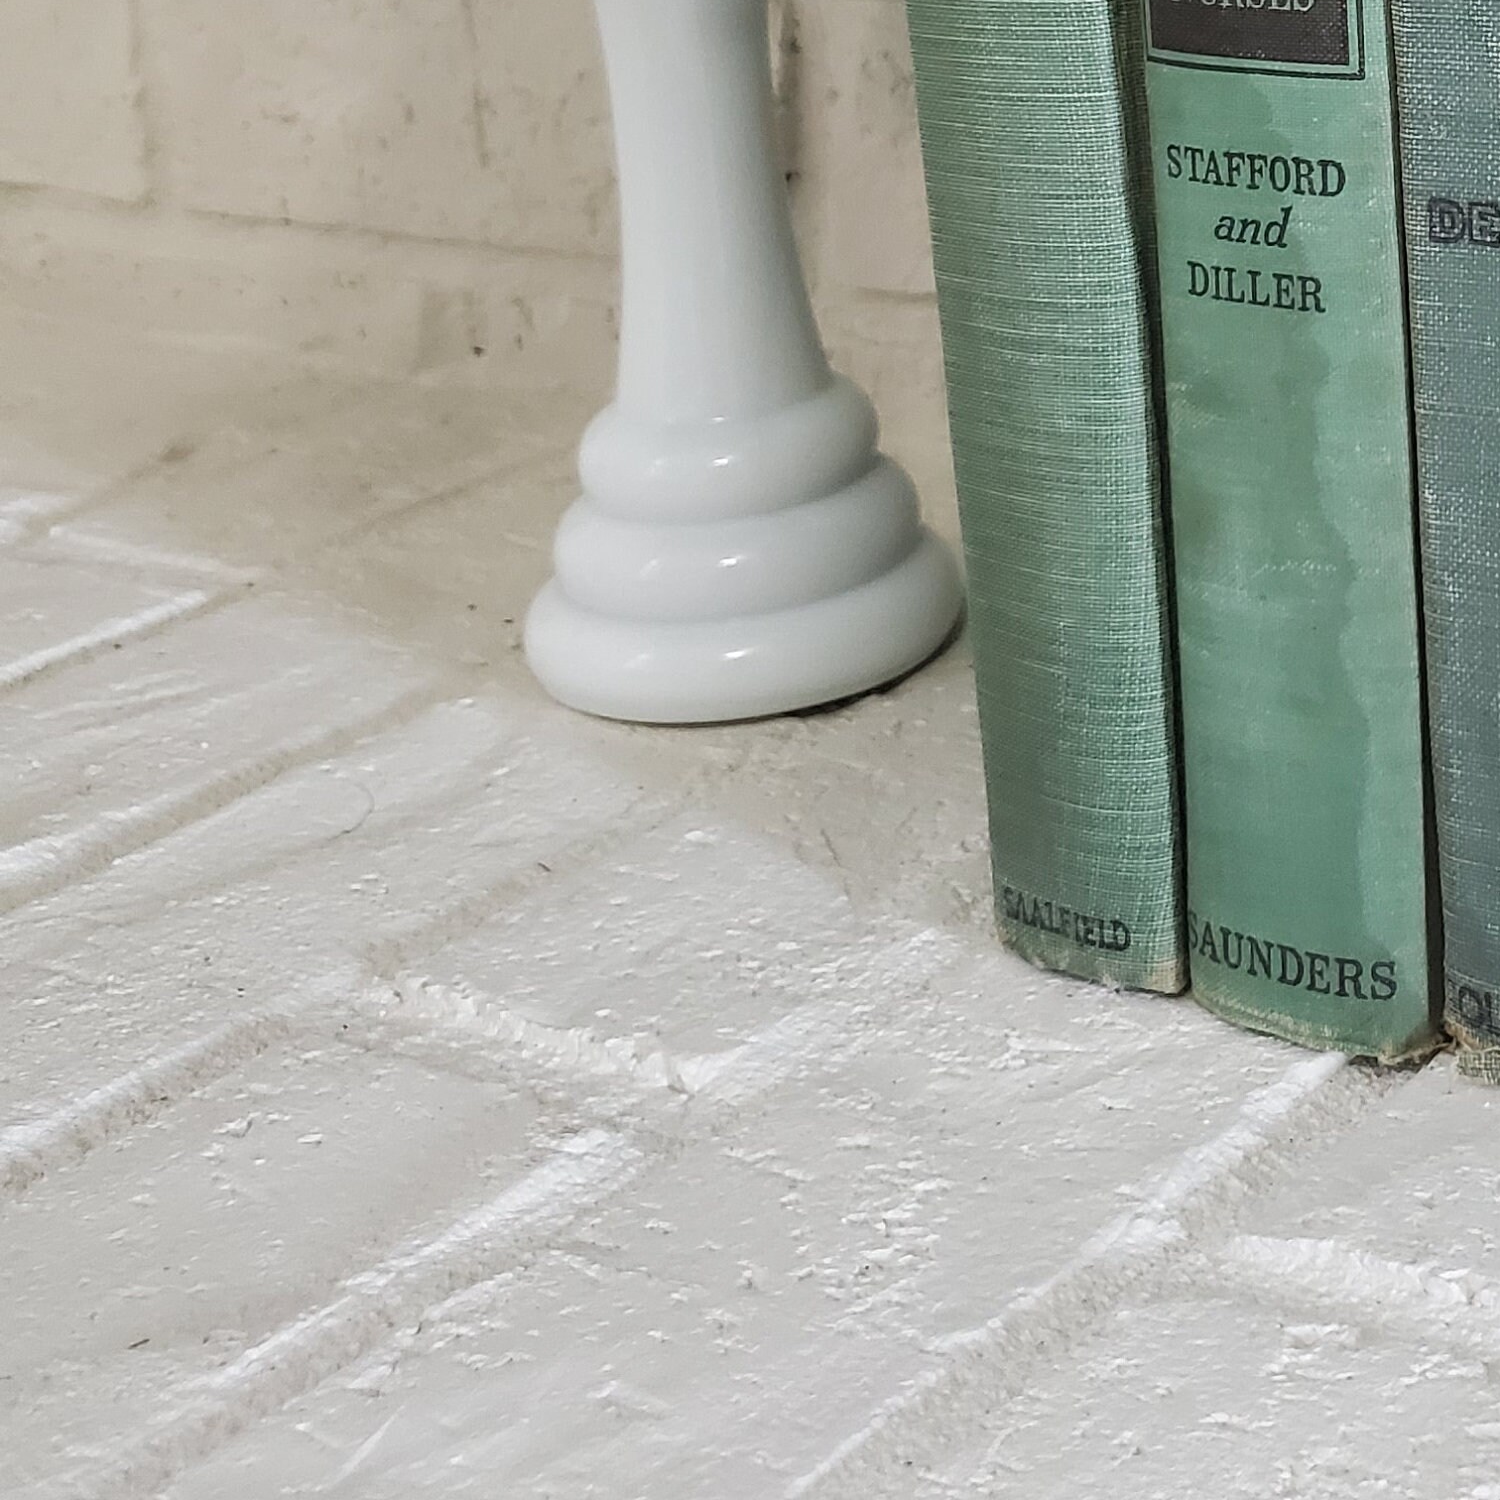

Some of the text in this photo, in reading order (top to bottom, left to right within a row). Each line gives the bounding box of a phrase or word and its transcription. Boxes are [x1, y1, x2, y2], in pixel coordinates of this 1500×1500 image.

[1166, 144, 1347, 197] STAFFORD
[1214, 206, 1294, 249] and
[1187, 261, 1326, 314] DILLER
[1187, 910, 1397, 1001] SAUNDERS
